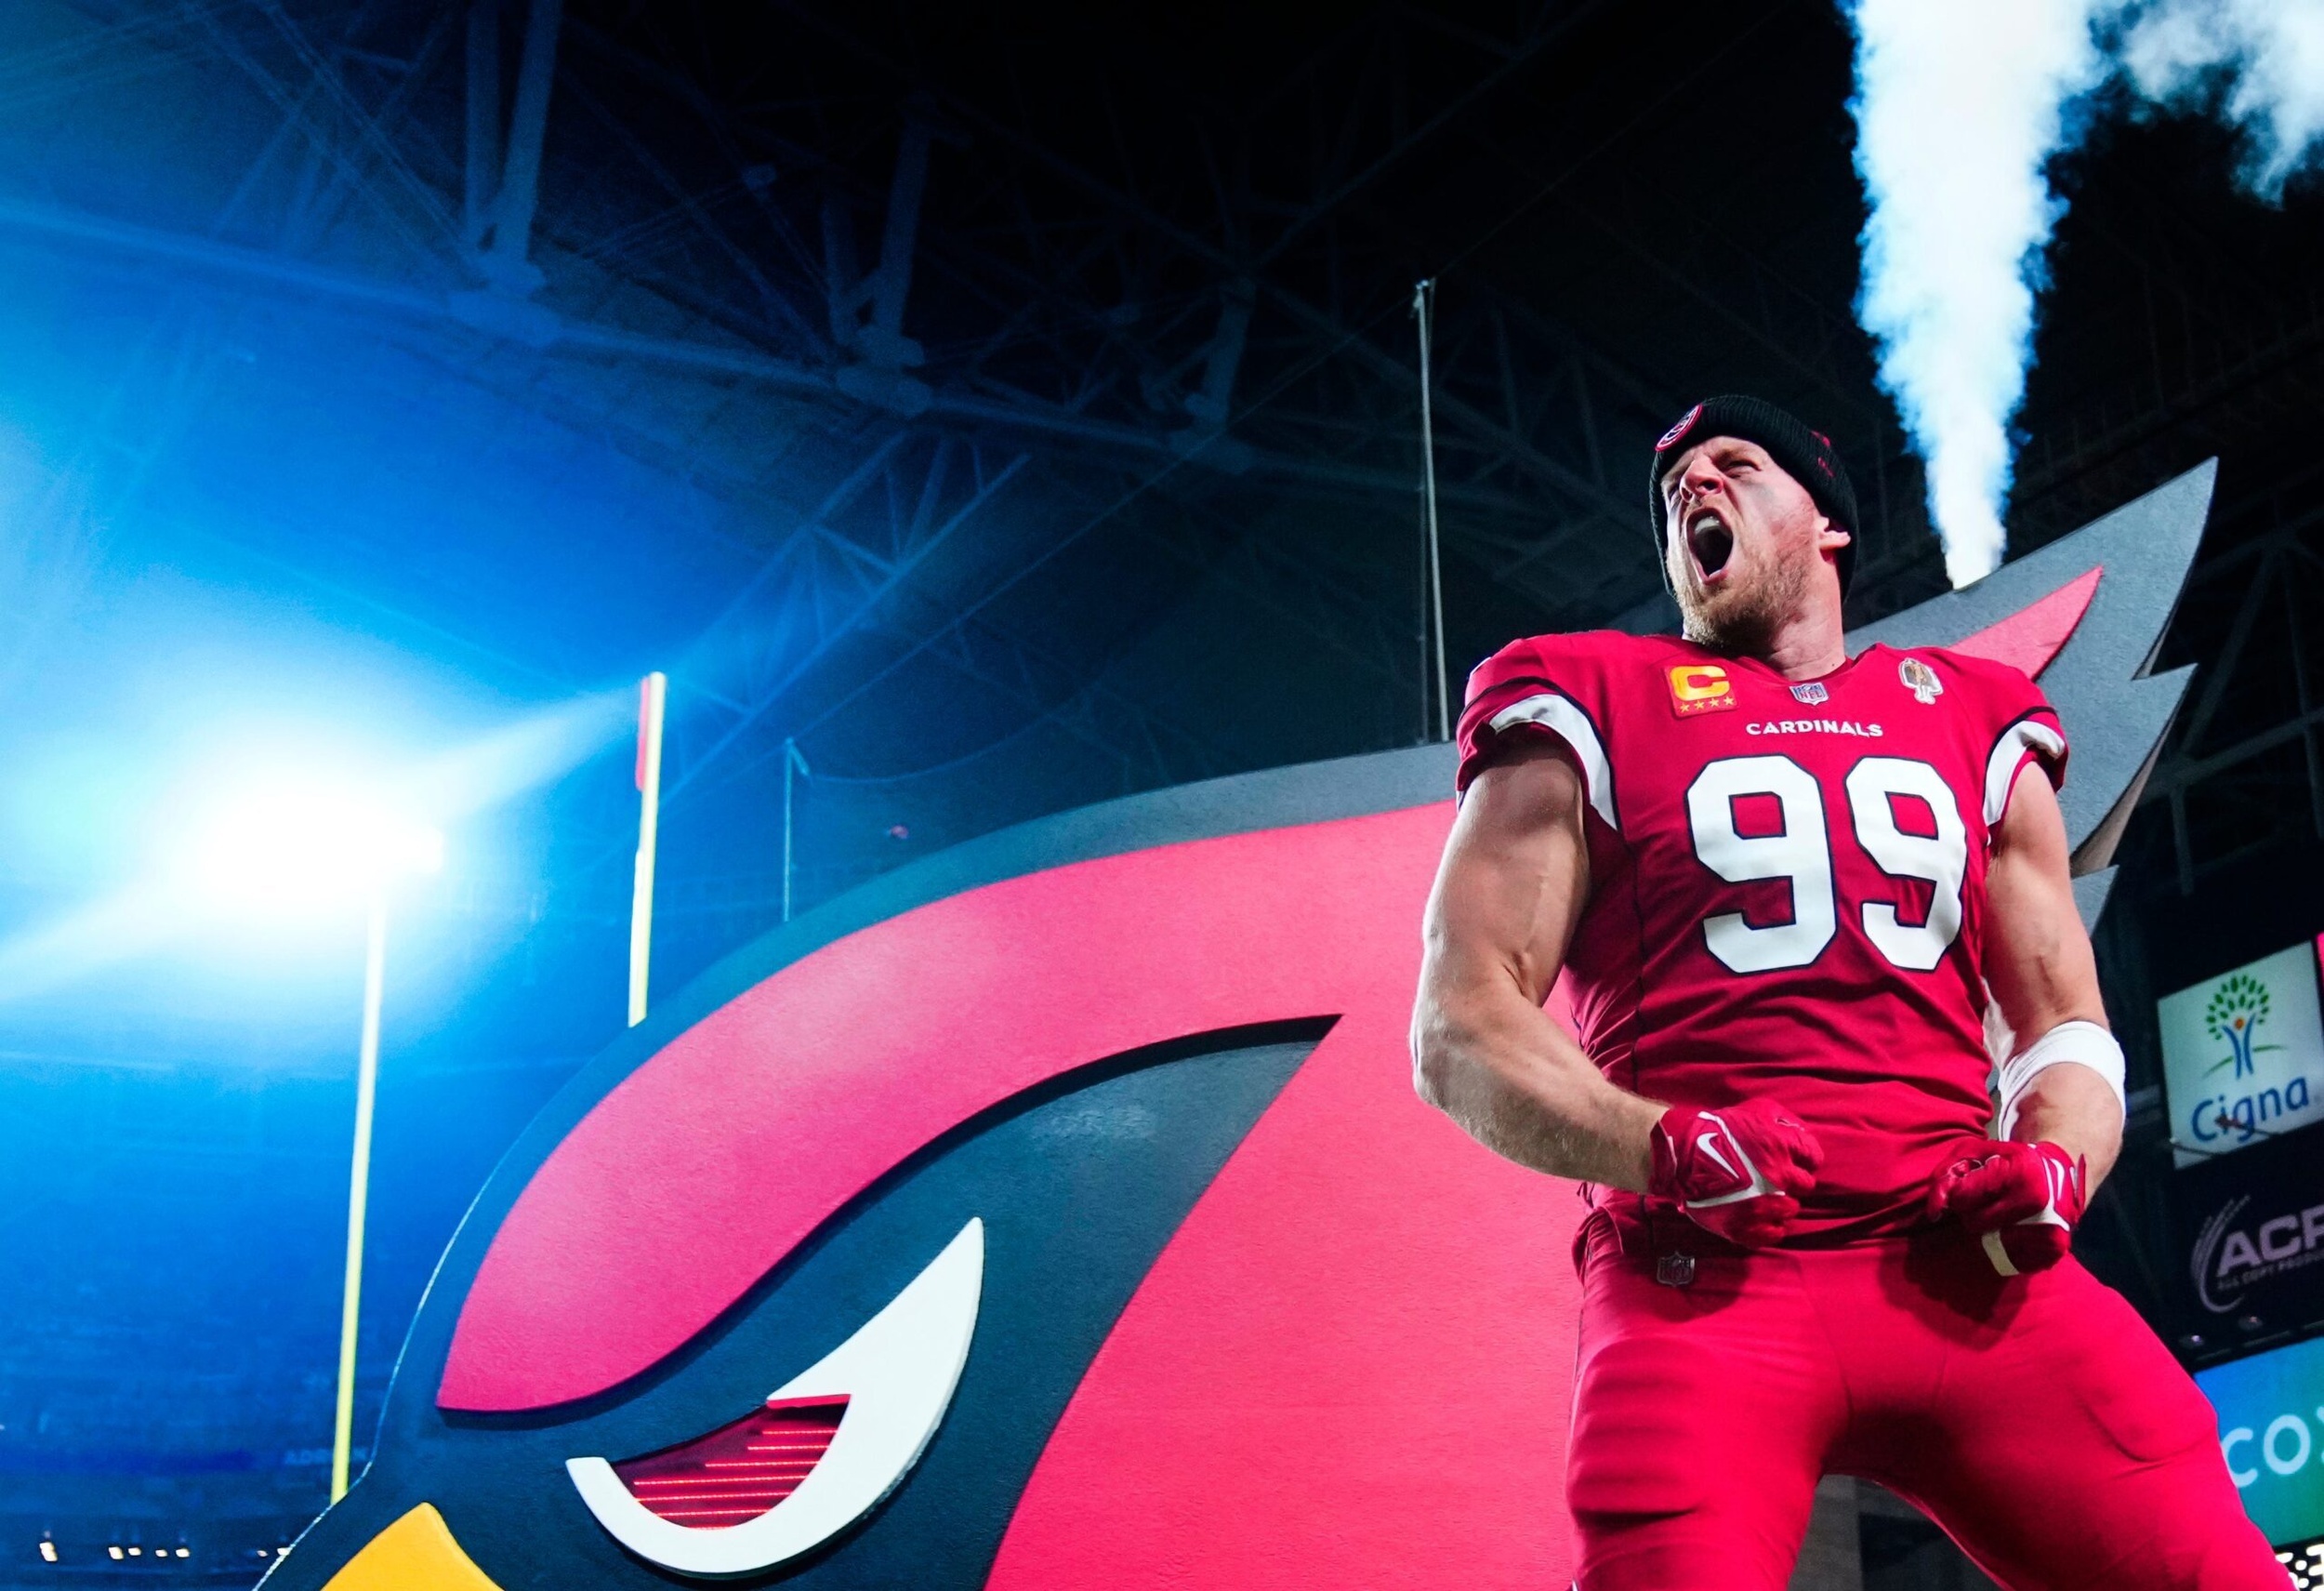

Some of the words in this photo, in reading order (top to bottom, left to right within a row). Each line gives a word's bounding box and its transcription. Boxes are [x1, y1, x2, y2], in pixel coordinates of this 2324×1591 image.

[1670, 665, 1731, 702] C
[1745, 720, 1883, 737] CARDINALS
[1685, 754, 1969, 974] 99
[2191, 1077, 2309, 1143] Cigna
[2222, 1405, 2324, 1488] CO
